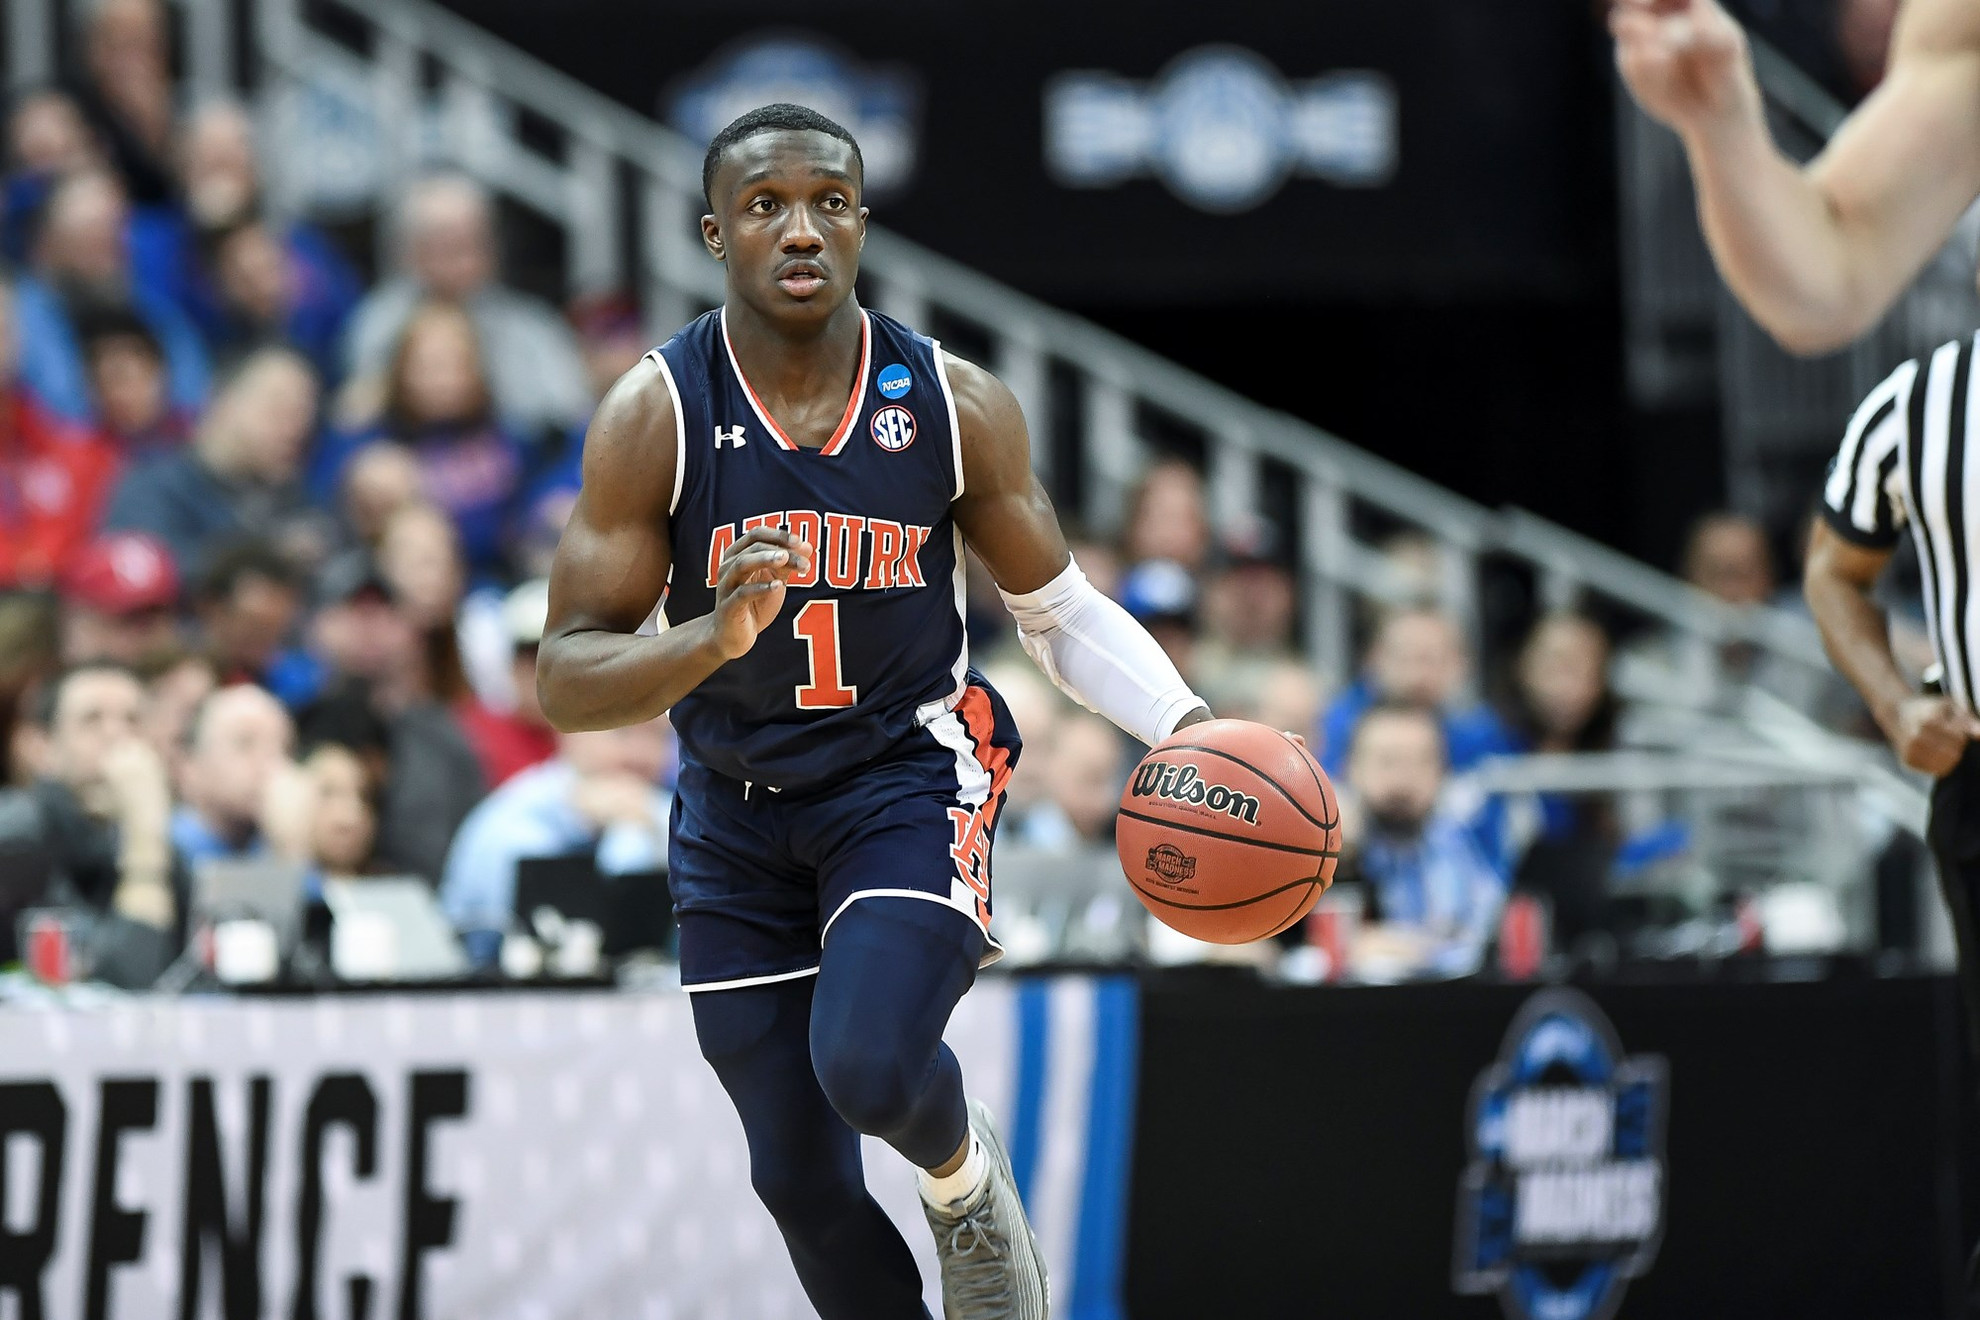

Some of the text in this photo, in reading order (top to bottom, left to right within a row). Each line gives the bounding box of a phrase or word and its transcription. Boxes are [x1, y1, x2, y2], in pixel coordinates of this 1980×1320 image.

[882, 377, 911, 392] NCAA
[874, 408, 913, 449] SEC
[793, 599, 857, 709] 1
[1132, 761, 1259, 826] Wilson
[1154, 852, 1182, 866] MARCH
[1158, 861, 1194, 878] MADNESS
